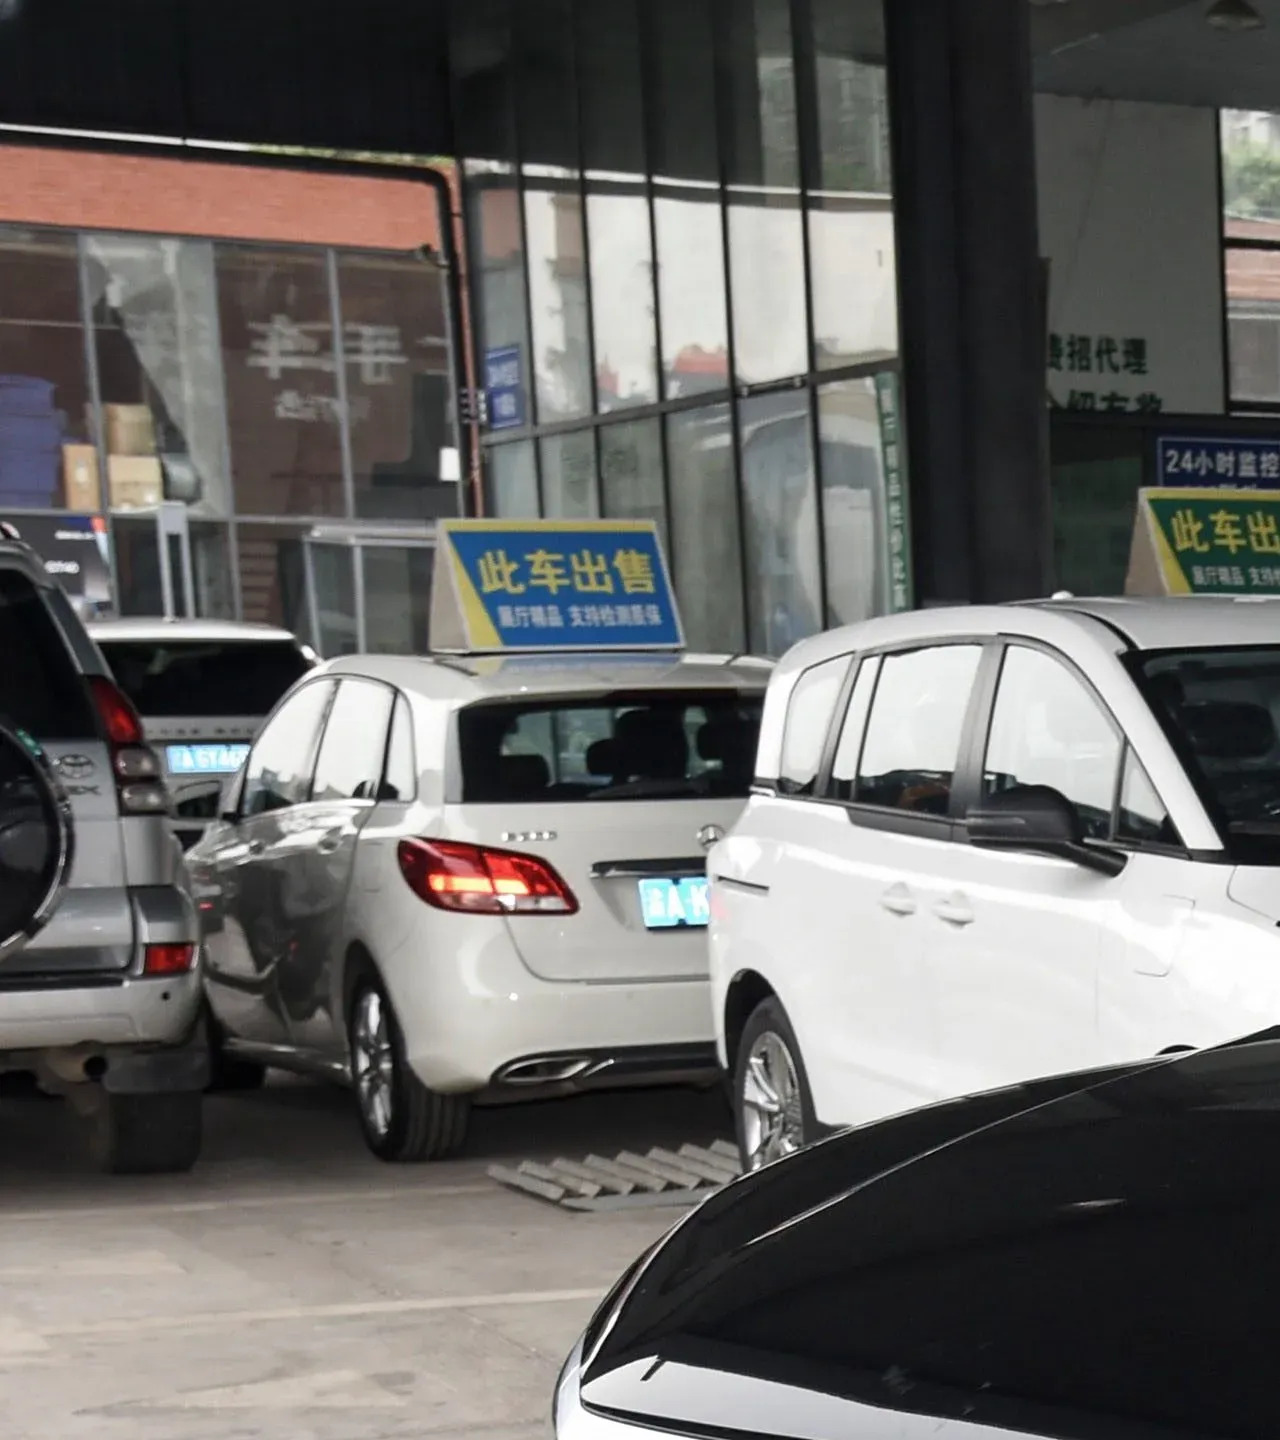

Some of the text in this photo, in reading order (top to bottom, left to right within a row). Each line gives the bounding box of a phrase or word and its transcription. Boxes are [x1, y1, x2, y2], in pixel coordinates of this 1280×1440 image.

[1165, 449, 1280, 478] 24小时监控
[477, 549, 656, 594] 此车出售
